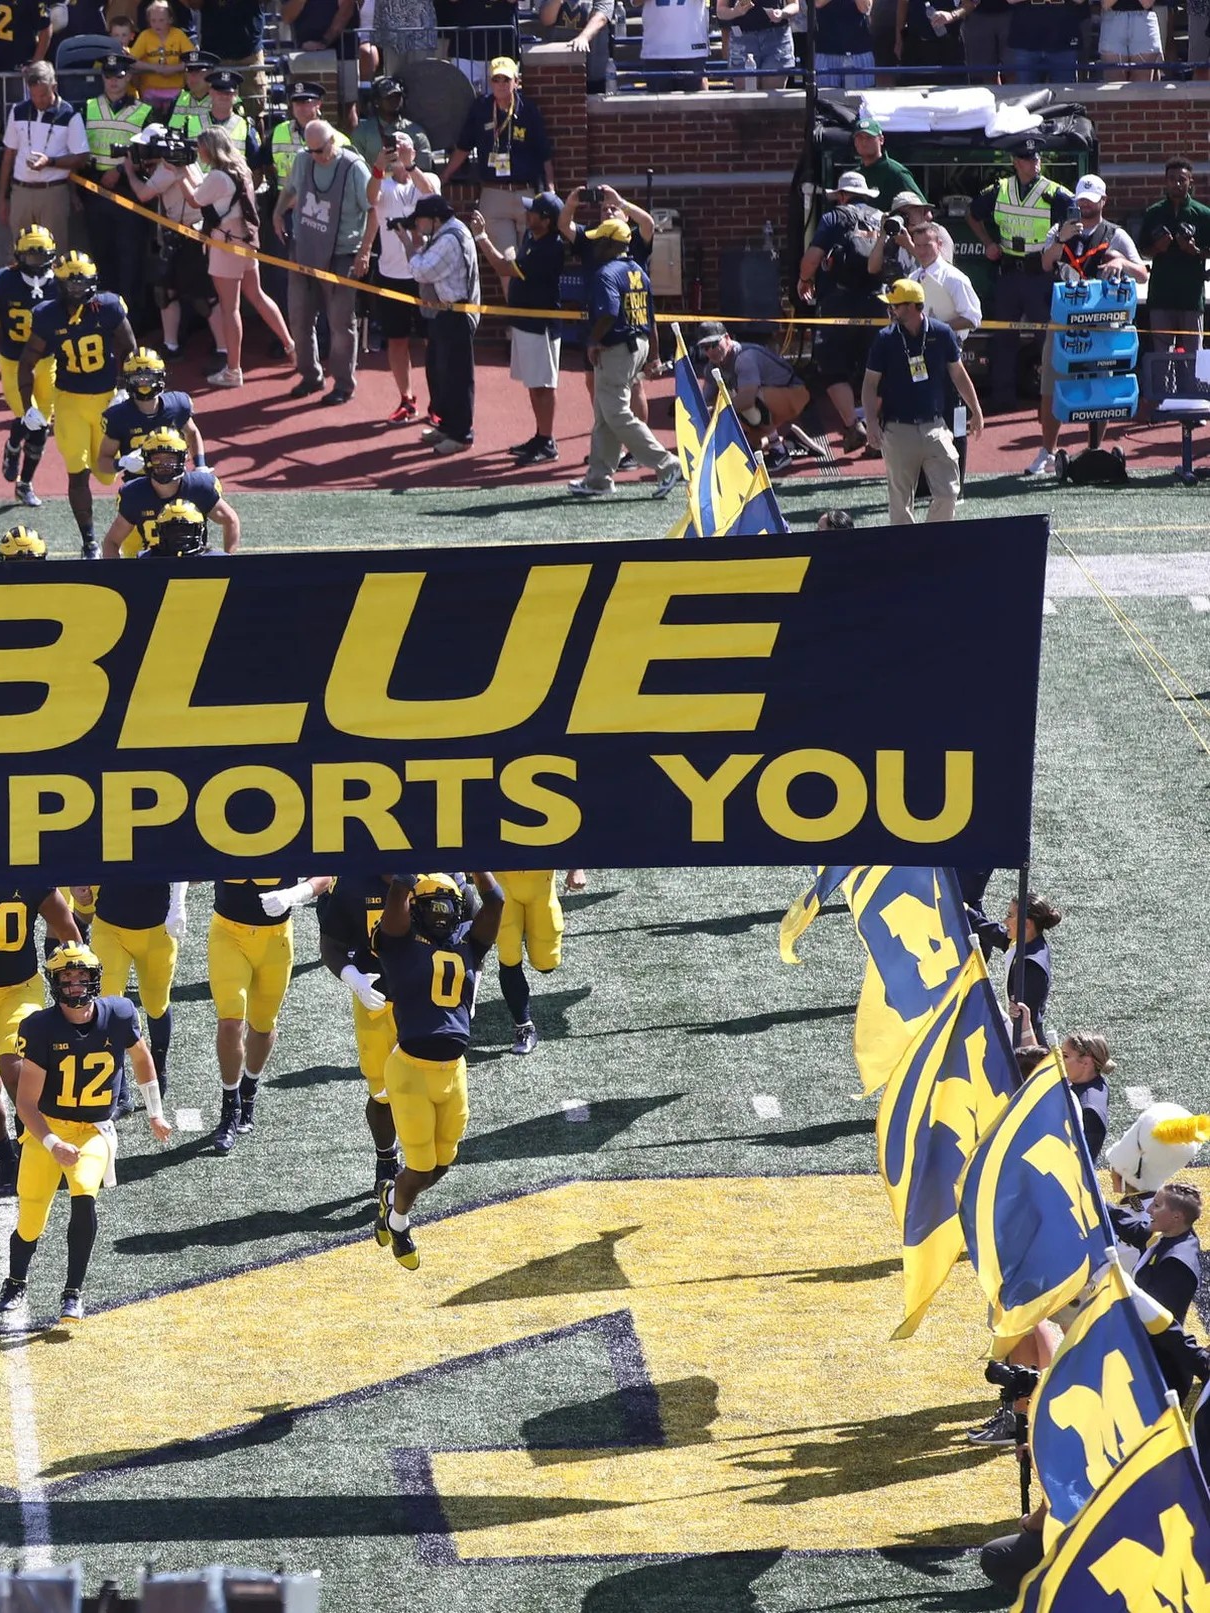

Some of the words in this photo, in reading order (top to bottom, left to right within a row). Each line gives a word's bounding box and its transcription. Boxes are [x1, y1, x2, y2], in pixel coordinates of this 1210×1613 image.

[301, 191, 331, 223] M
[8, 308, 33, 342] 3
[1070, 311, 1127, 324] POWERADE
[61, 333, 105, 373] 18
[1072, 408, 1128, 420] POWERADE
[653, 749, 973, 842] YOU
[431, 950, 466, 1008] 0
[56, 1051, 115, 1108] 12
